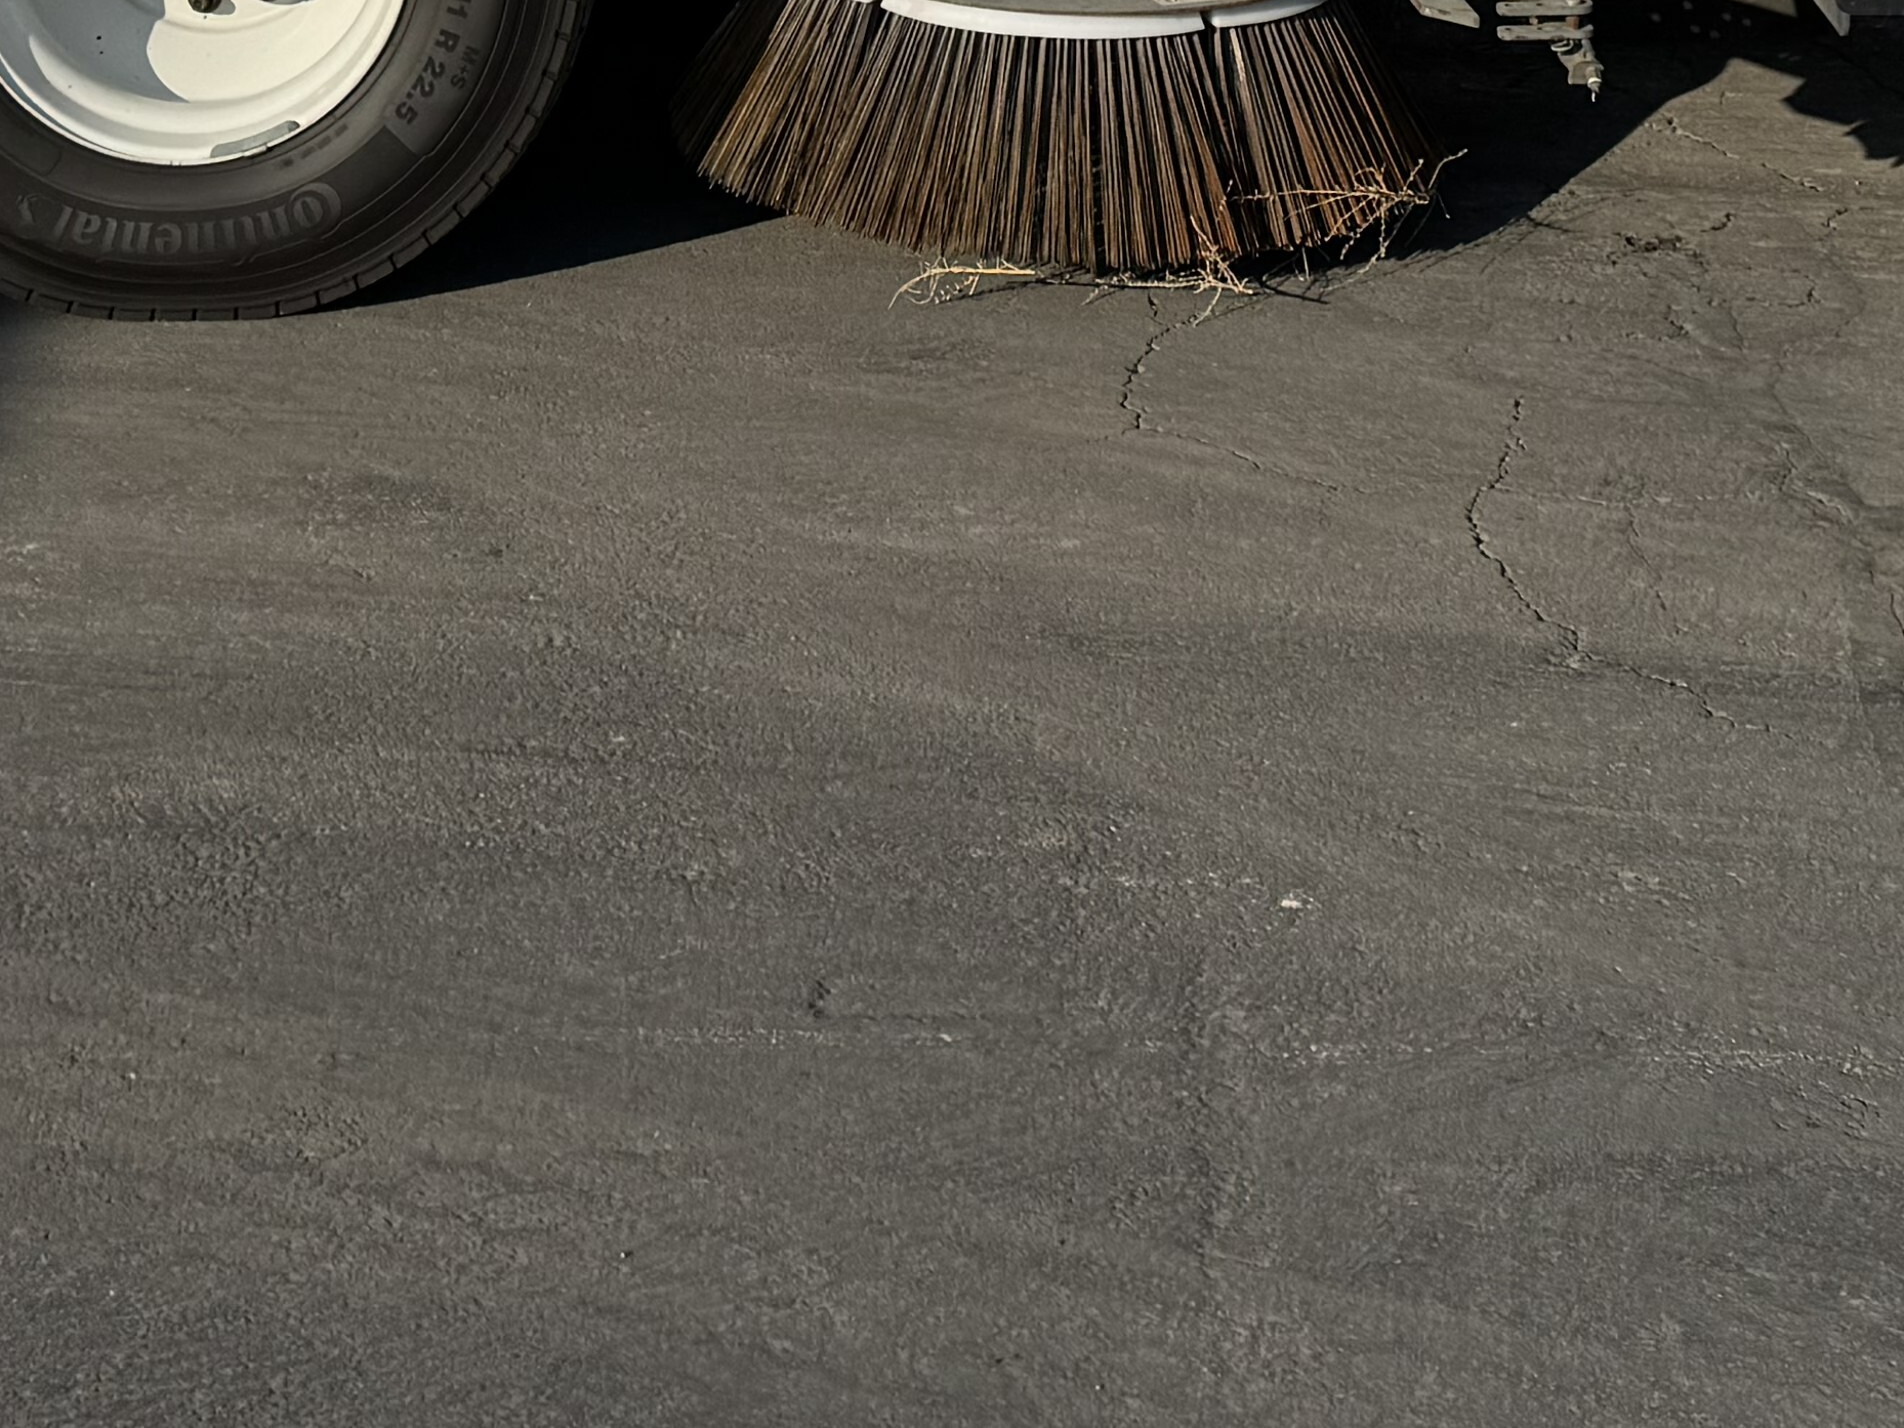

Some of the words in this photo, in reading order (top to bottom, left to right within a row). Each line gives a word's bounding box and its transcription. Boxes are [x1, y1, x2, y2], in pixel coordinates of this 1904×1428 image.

[434, 28, 461, 53] R
[451, 46, 480, 89] M+S
[395, 56, 446, 125] 22.5
